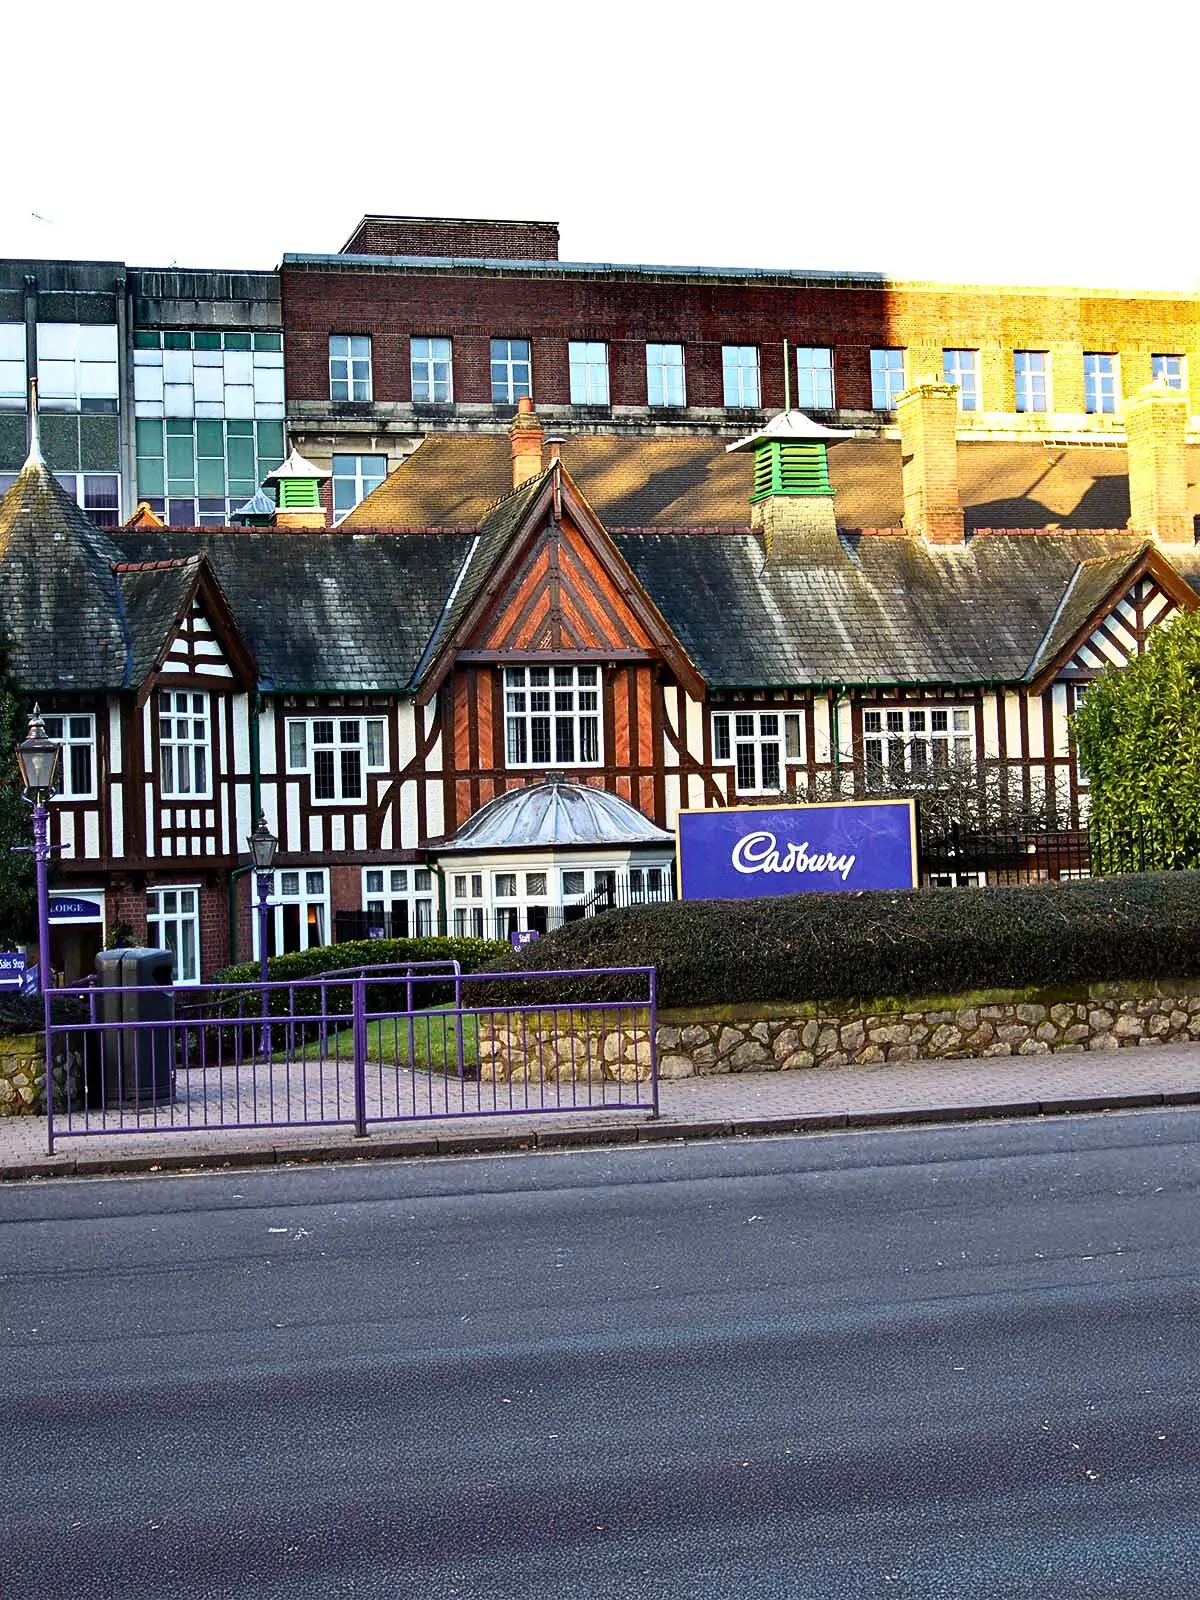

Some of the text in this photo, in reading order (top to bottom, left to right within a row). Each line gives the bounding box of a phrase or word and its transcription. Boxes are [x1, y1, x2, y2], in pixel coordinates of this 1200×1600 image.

[731, 830, 856, 881] Cadbury
[50, 903, 84, 913] LODGE
[12, 958, 25, 971] Shop
